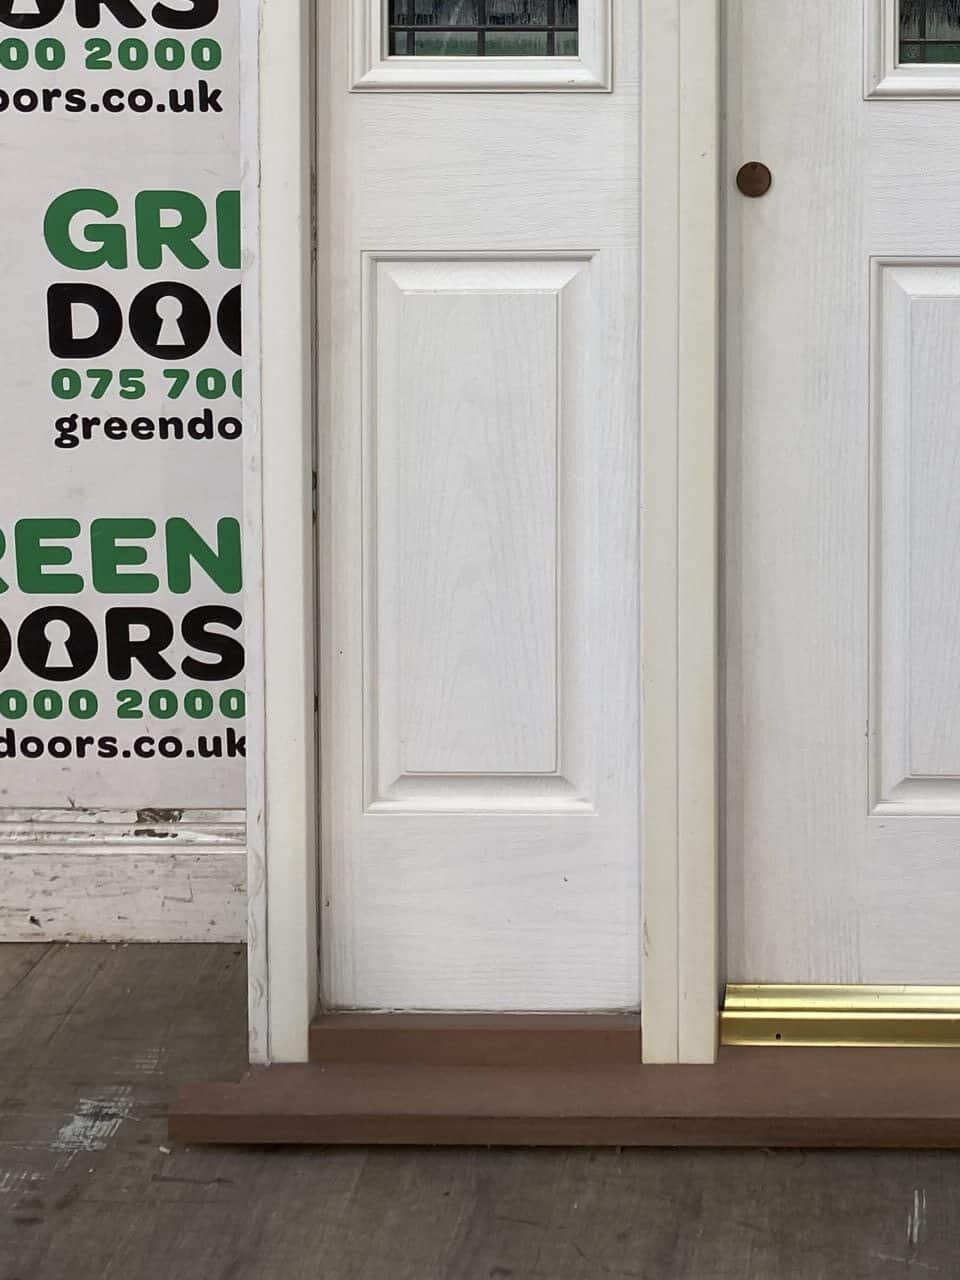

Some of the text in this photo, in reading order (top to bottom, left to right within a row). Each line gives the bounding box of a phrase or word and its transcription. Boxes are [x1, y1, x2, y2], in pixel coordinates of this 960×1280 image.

[84, 37, 222, 70] 2000
[51, 368, 146, 400] 075
[0, 517, 243, 594] EEN
[0, 605, 246, 682] ORS
[116, 689, 246, 720] 2000
